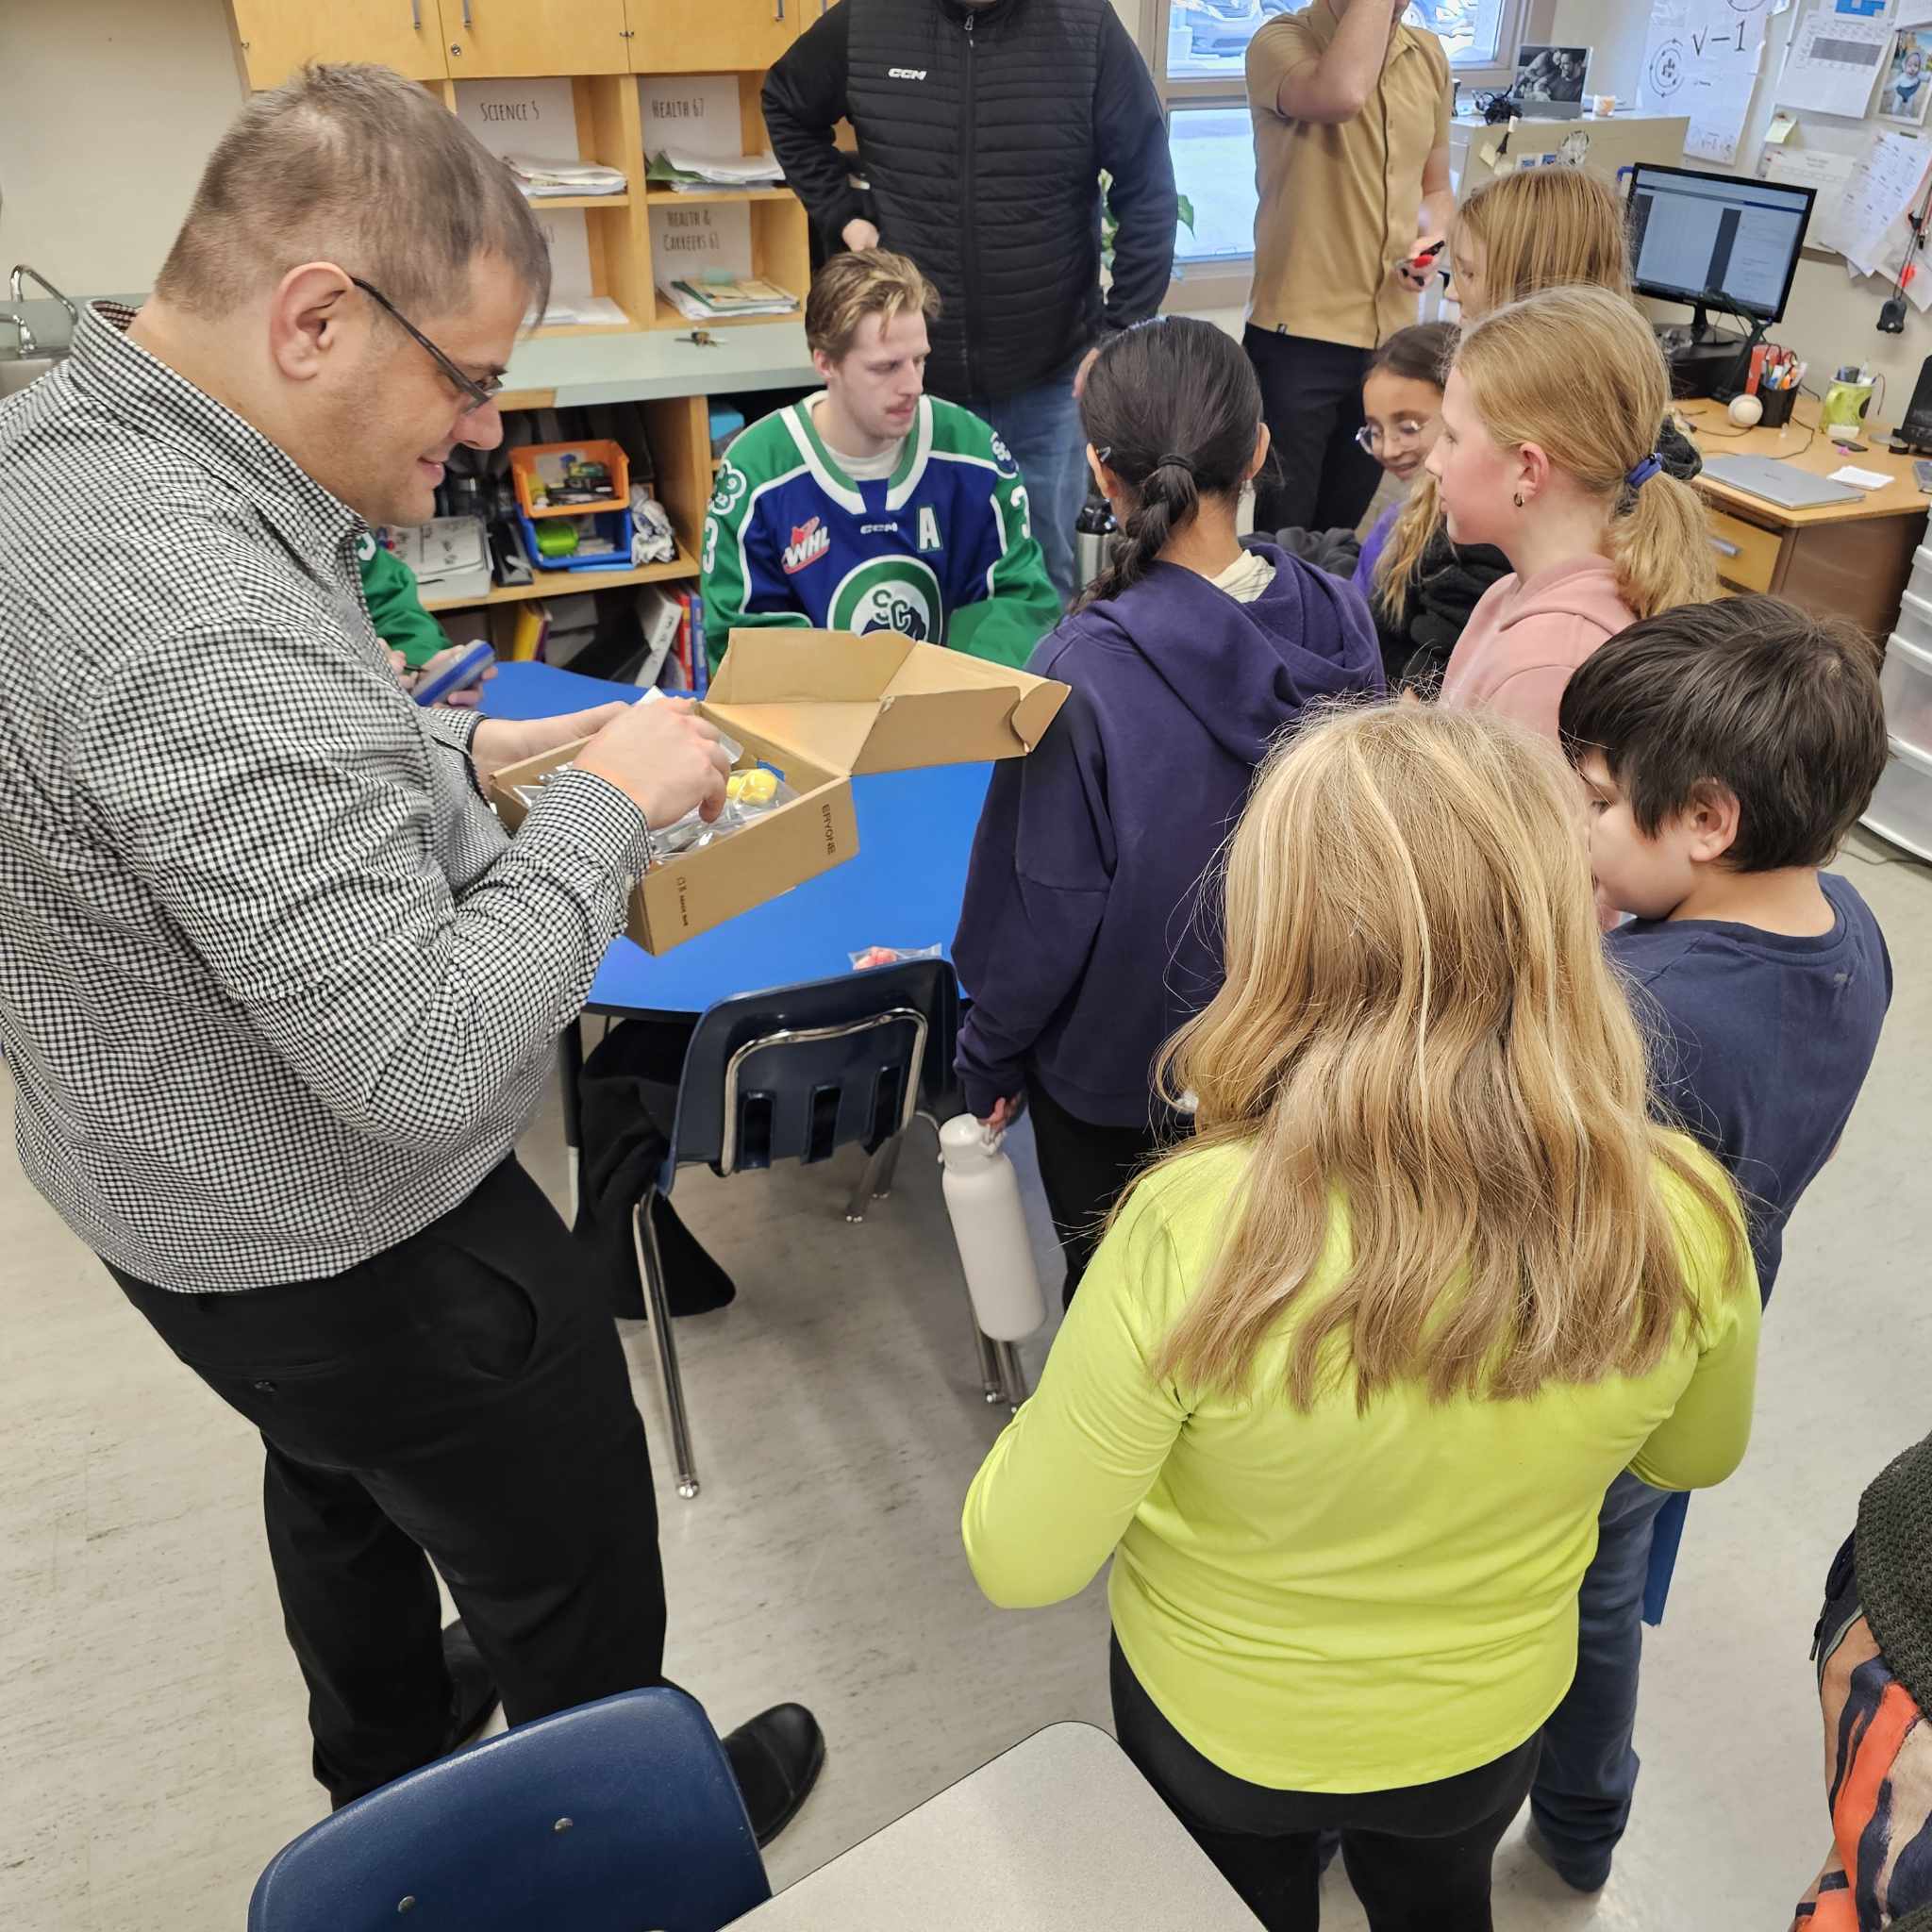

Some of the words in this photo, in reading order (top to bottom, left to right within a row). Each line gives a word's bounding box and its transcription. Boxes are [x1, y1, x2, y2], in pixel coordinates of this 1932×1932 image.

[888, 68, 927, 81] CCM
[479, 102, 528, 122] SCIENCE
[651, 99, 690, 120] HEALTH
[859, 522, 898, 535] CCM
[917, 506, 941, 550] A
[784, 525, 831, 568] WHL
